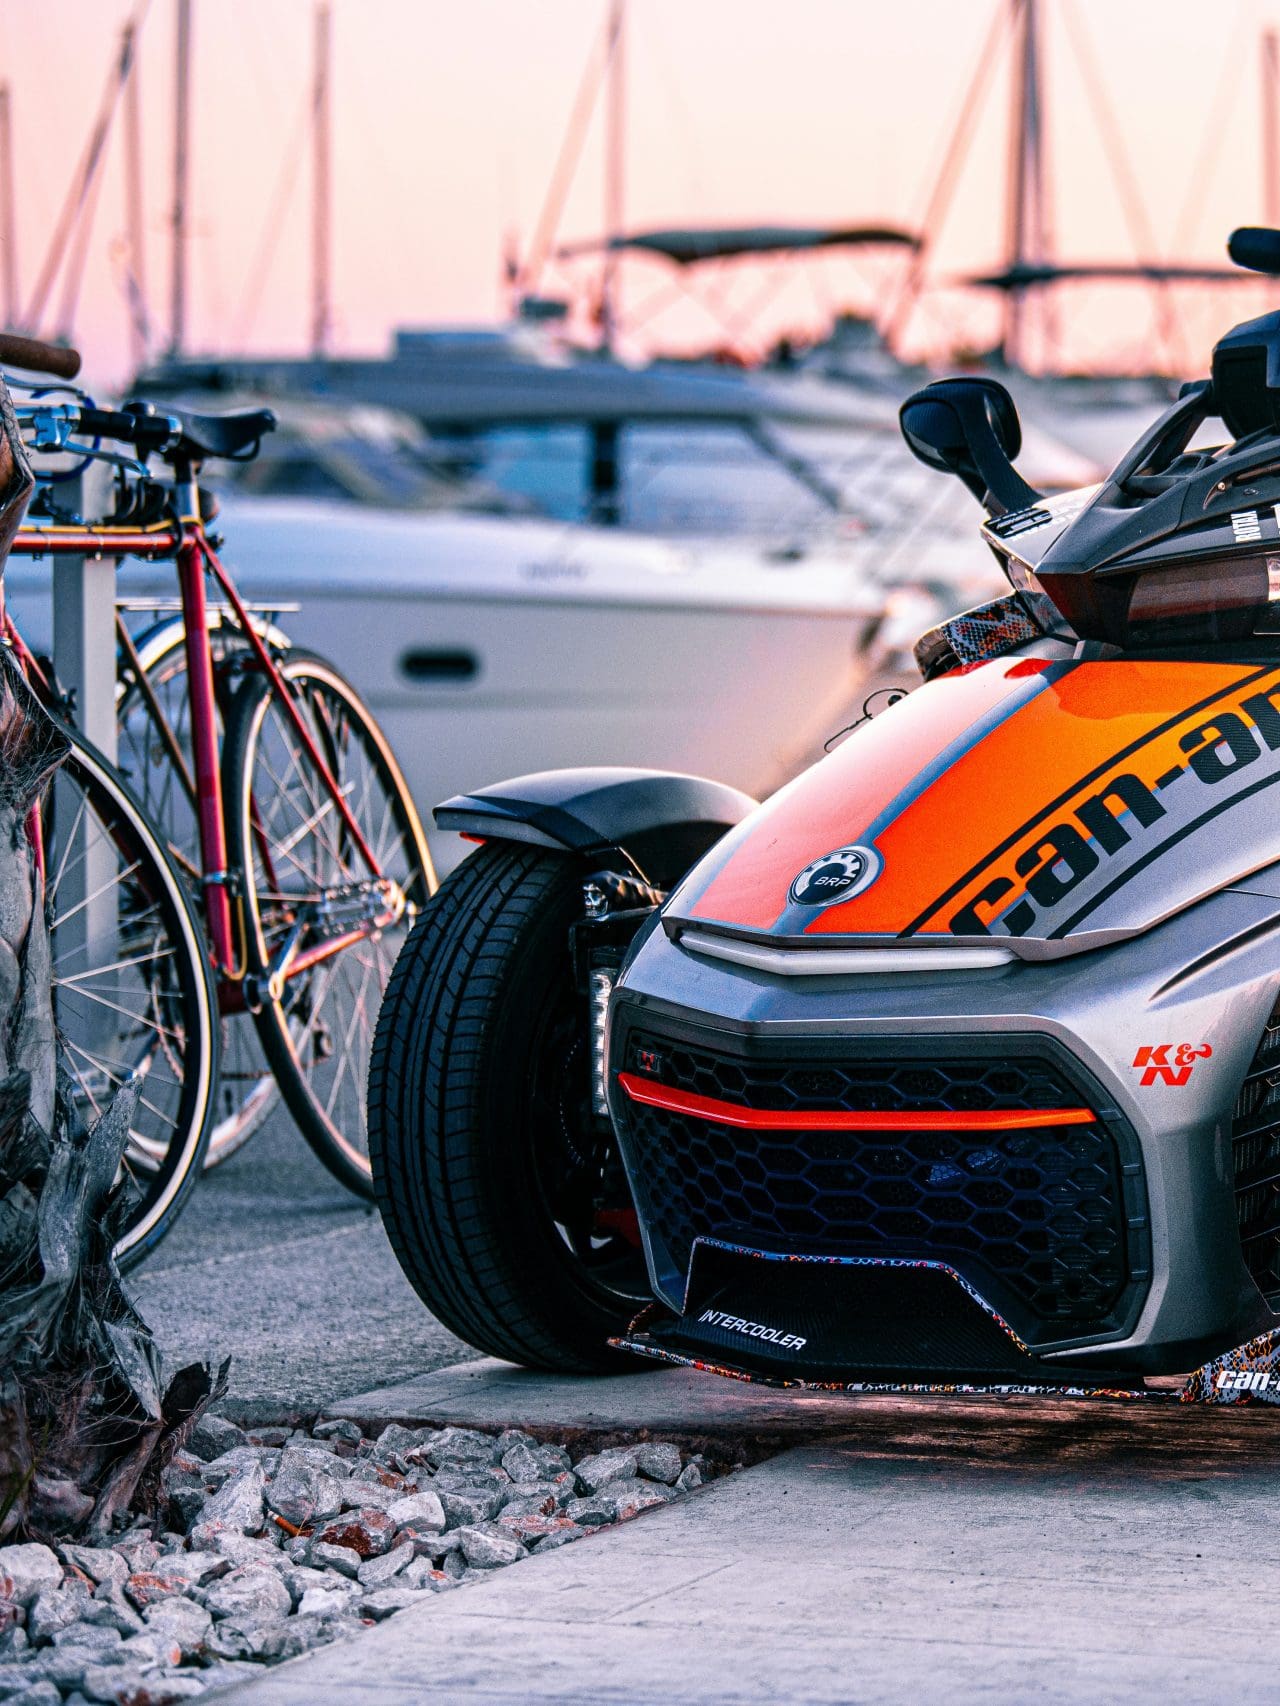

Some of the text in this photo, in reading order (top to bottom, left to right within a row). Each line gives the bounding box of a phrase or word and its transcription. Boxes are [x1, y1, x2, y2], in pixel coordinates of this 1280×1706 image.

[1230, 510, 1262, 543] ROTAX
[814, 876, 851, 887] BRP
[698, 1309, 807, 1351] INTERCOOLER
